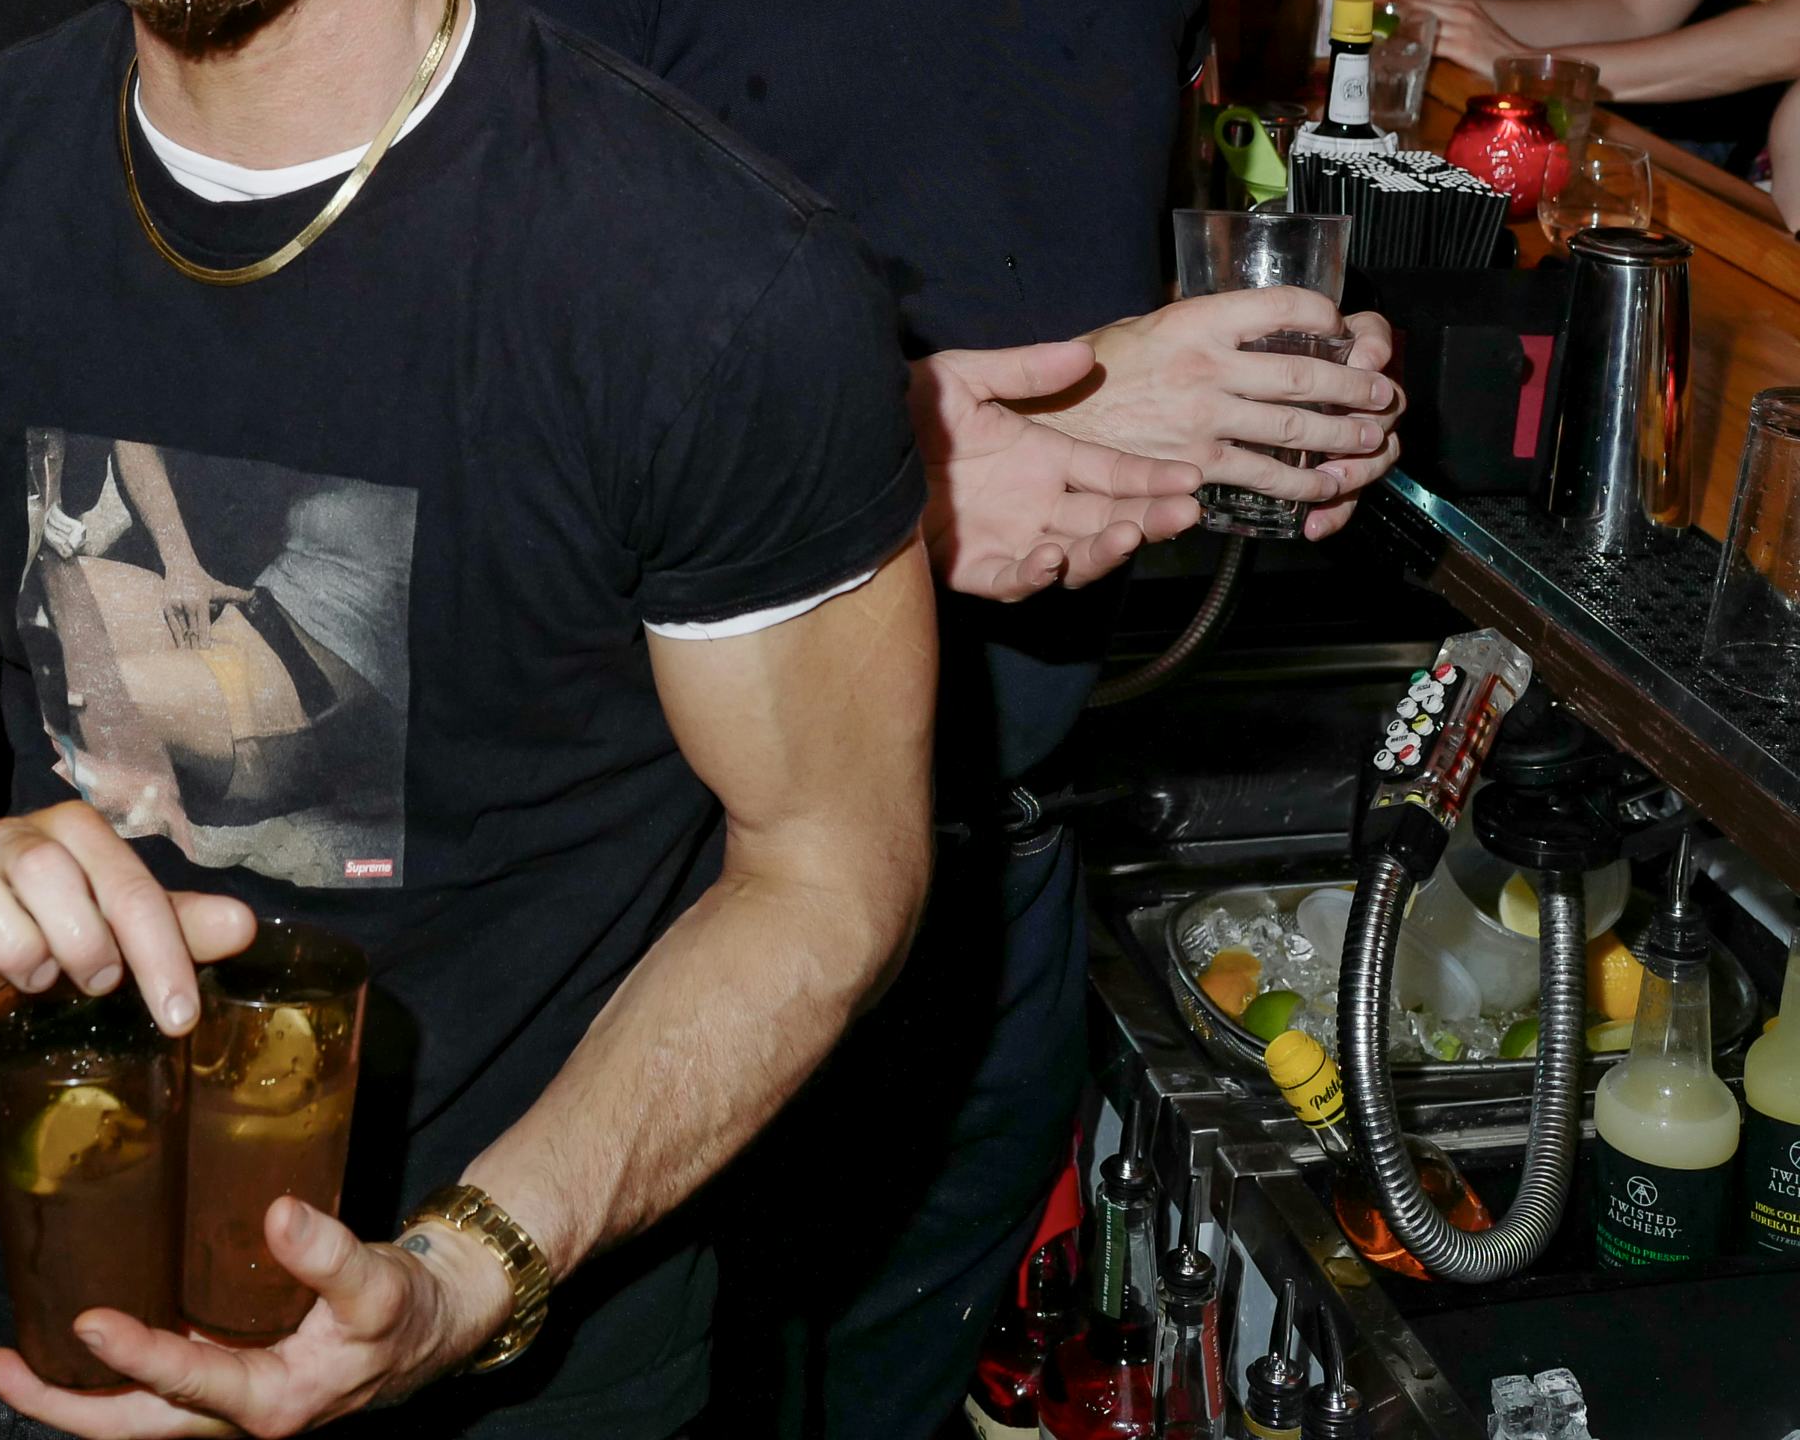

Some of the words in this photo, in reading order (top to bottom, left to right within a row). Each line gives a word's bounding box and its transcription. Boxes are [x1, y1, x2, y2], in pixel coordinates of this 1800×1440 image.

[1426, 694, 1435, 705] T
[1389, 721, 1400, 731] G
[345, 861, 392, 877] Supreme
[1609, 1195, 1677, 1227] TWISTED
[1750, 1210, 1788, 1233] EUREKA
[1613, 1237, 1641, 1255] COLD
